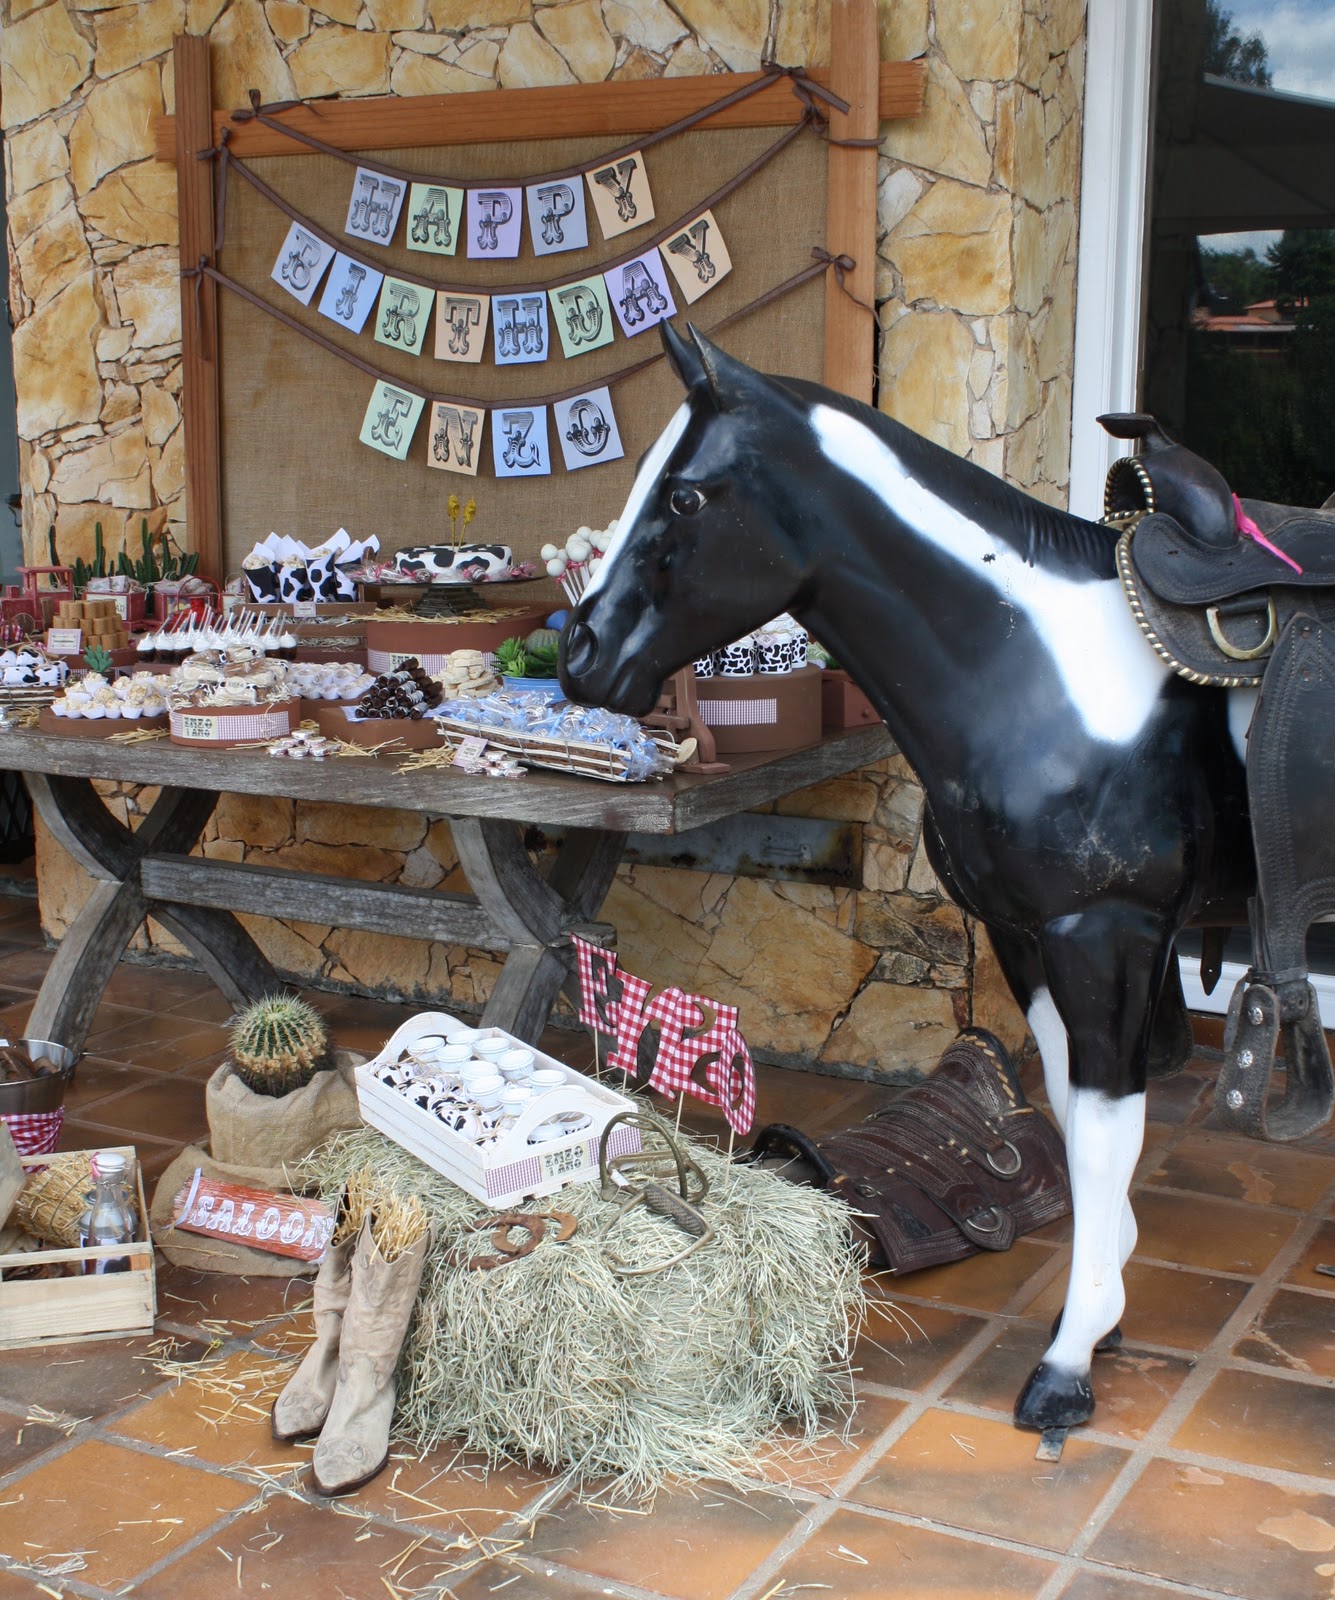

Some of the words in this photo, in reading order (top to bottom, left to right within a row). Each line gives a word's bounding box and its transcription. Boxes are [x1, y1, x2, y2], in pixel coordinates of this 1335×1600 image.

[350, 158, 638, 251] HAPPY
[281, 219, 717, 357] BIRTHDAY
[371, 385, 611, 469] ENZO
[184, 717, 212, 729] ENZO
[544, 1145, 584, 1168] ENZO
[187, 1195, 334, 1249] SALOON
